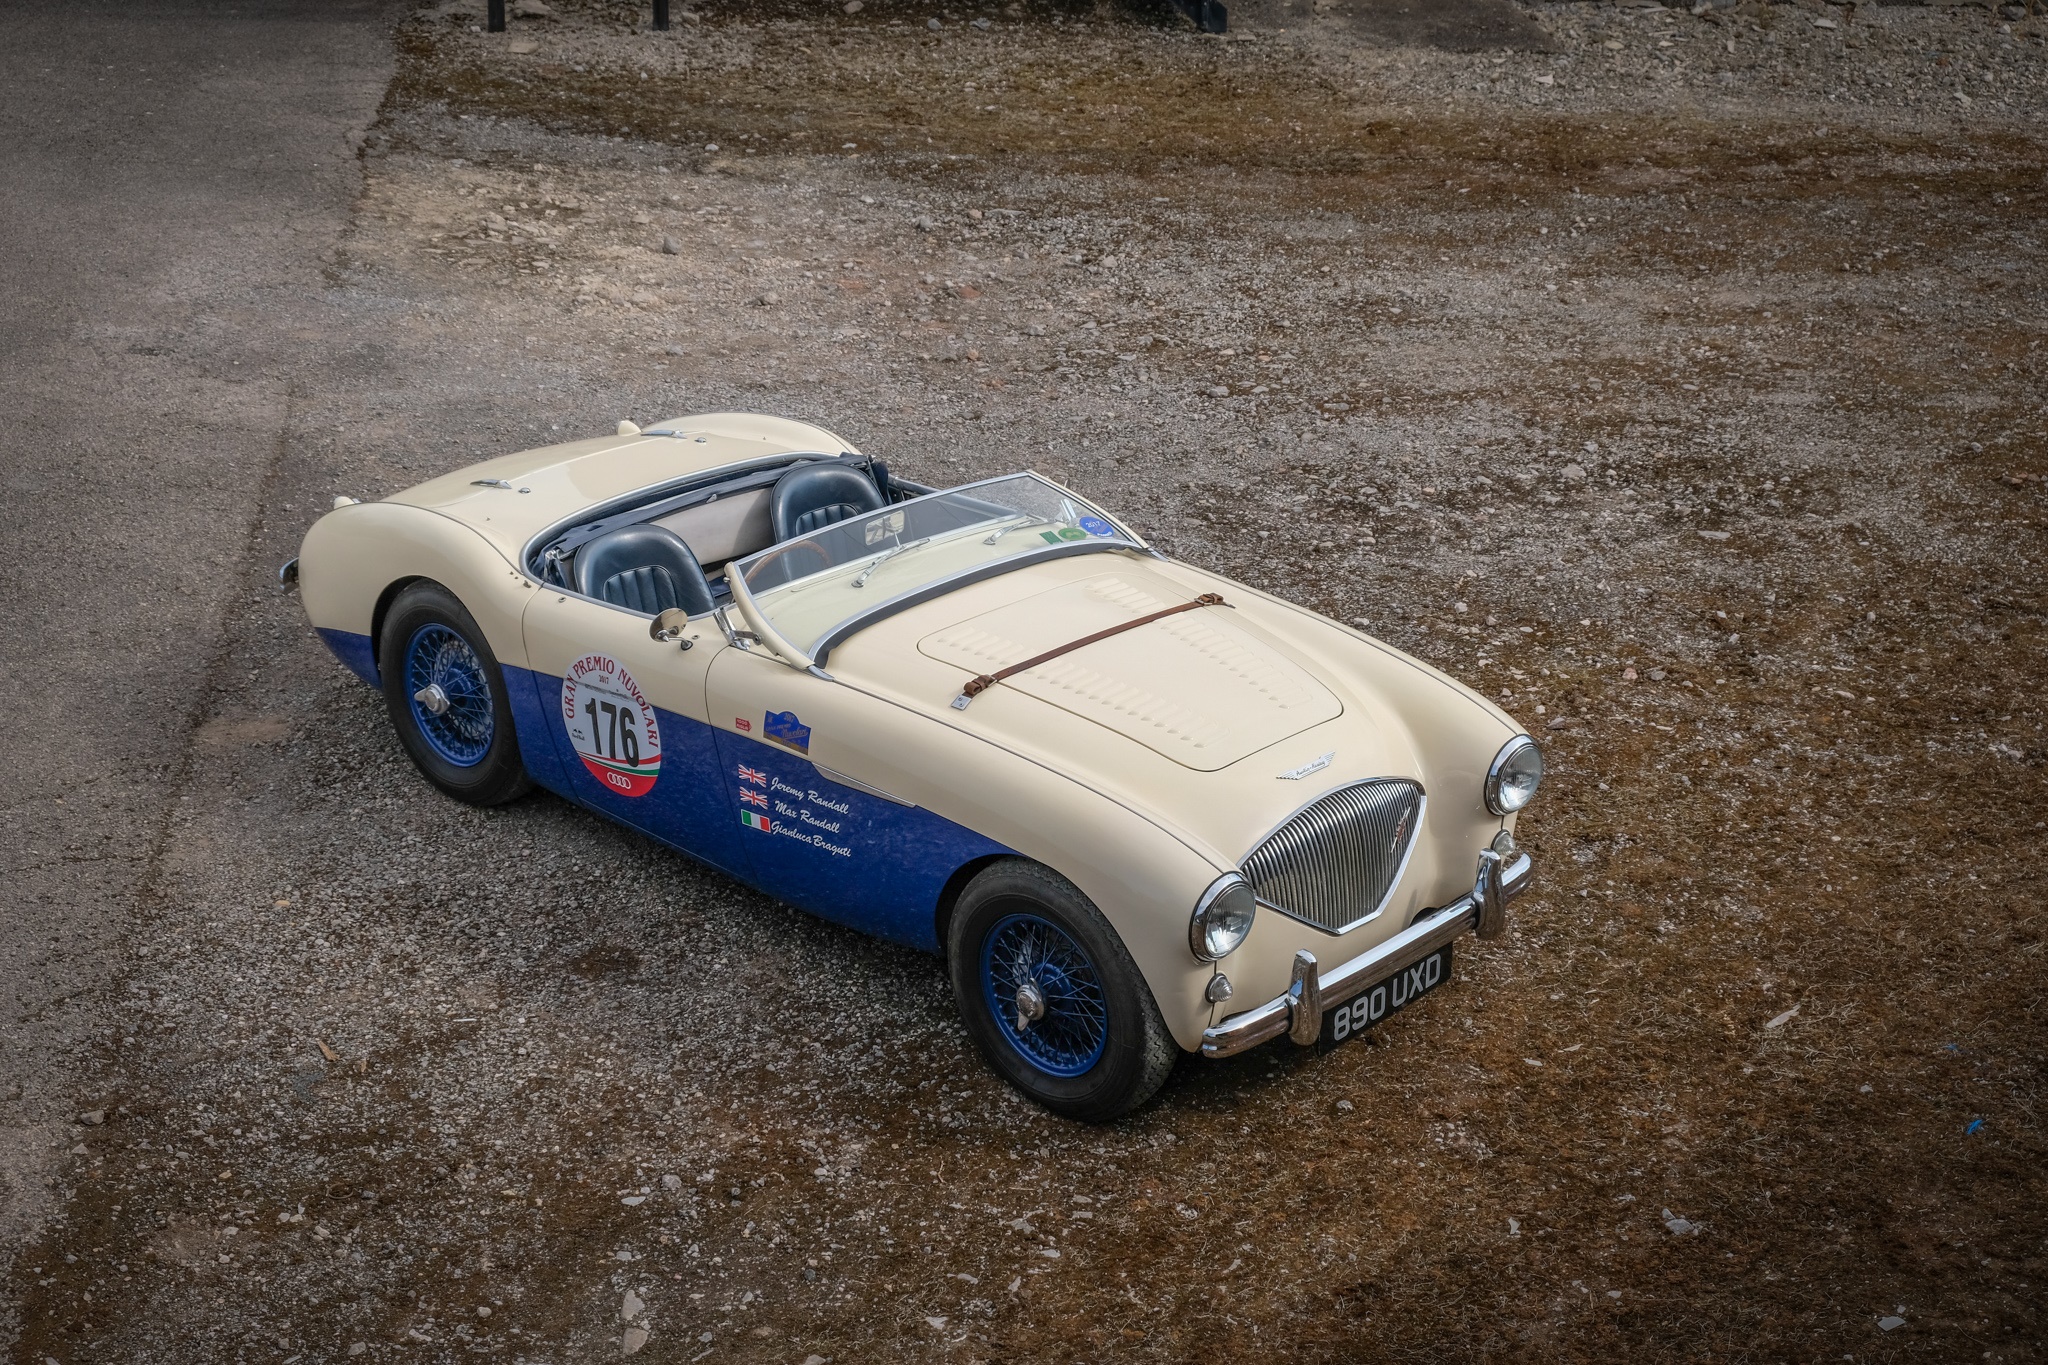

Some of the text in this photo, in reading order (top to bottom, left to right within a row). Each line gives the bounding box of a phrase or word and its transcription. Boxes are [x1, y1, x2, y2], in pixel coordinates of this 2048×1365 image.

[598, 674, 609, 684] 2017
[564, 656, 659, 748] GRAN PREMIO NUVOLARI
[584, 697, 640, 768] 176
[770, 776, 849, 815] Jeremy Randall
[774, 800, 840, 834] Max Randall
[771, 820, 852, 857] Gianluca Braguti
[1333, 952, 1442, 1042] 890 UXD
